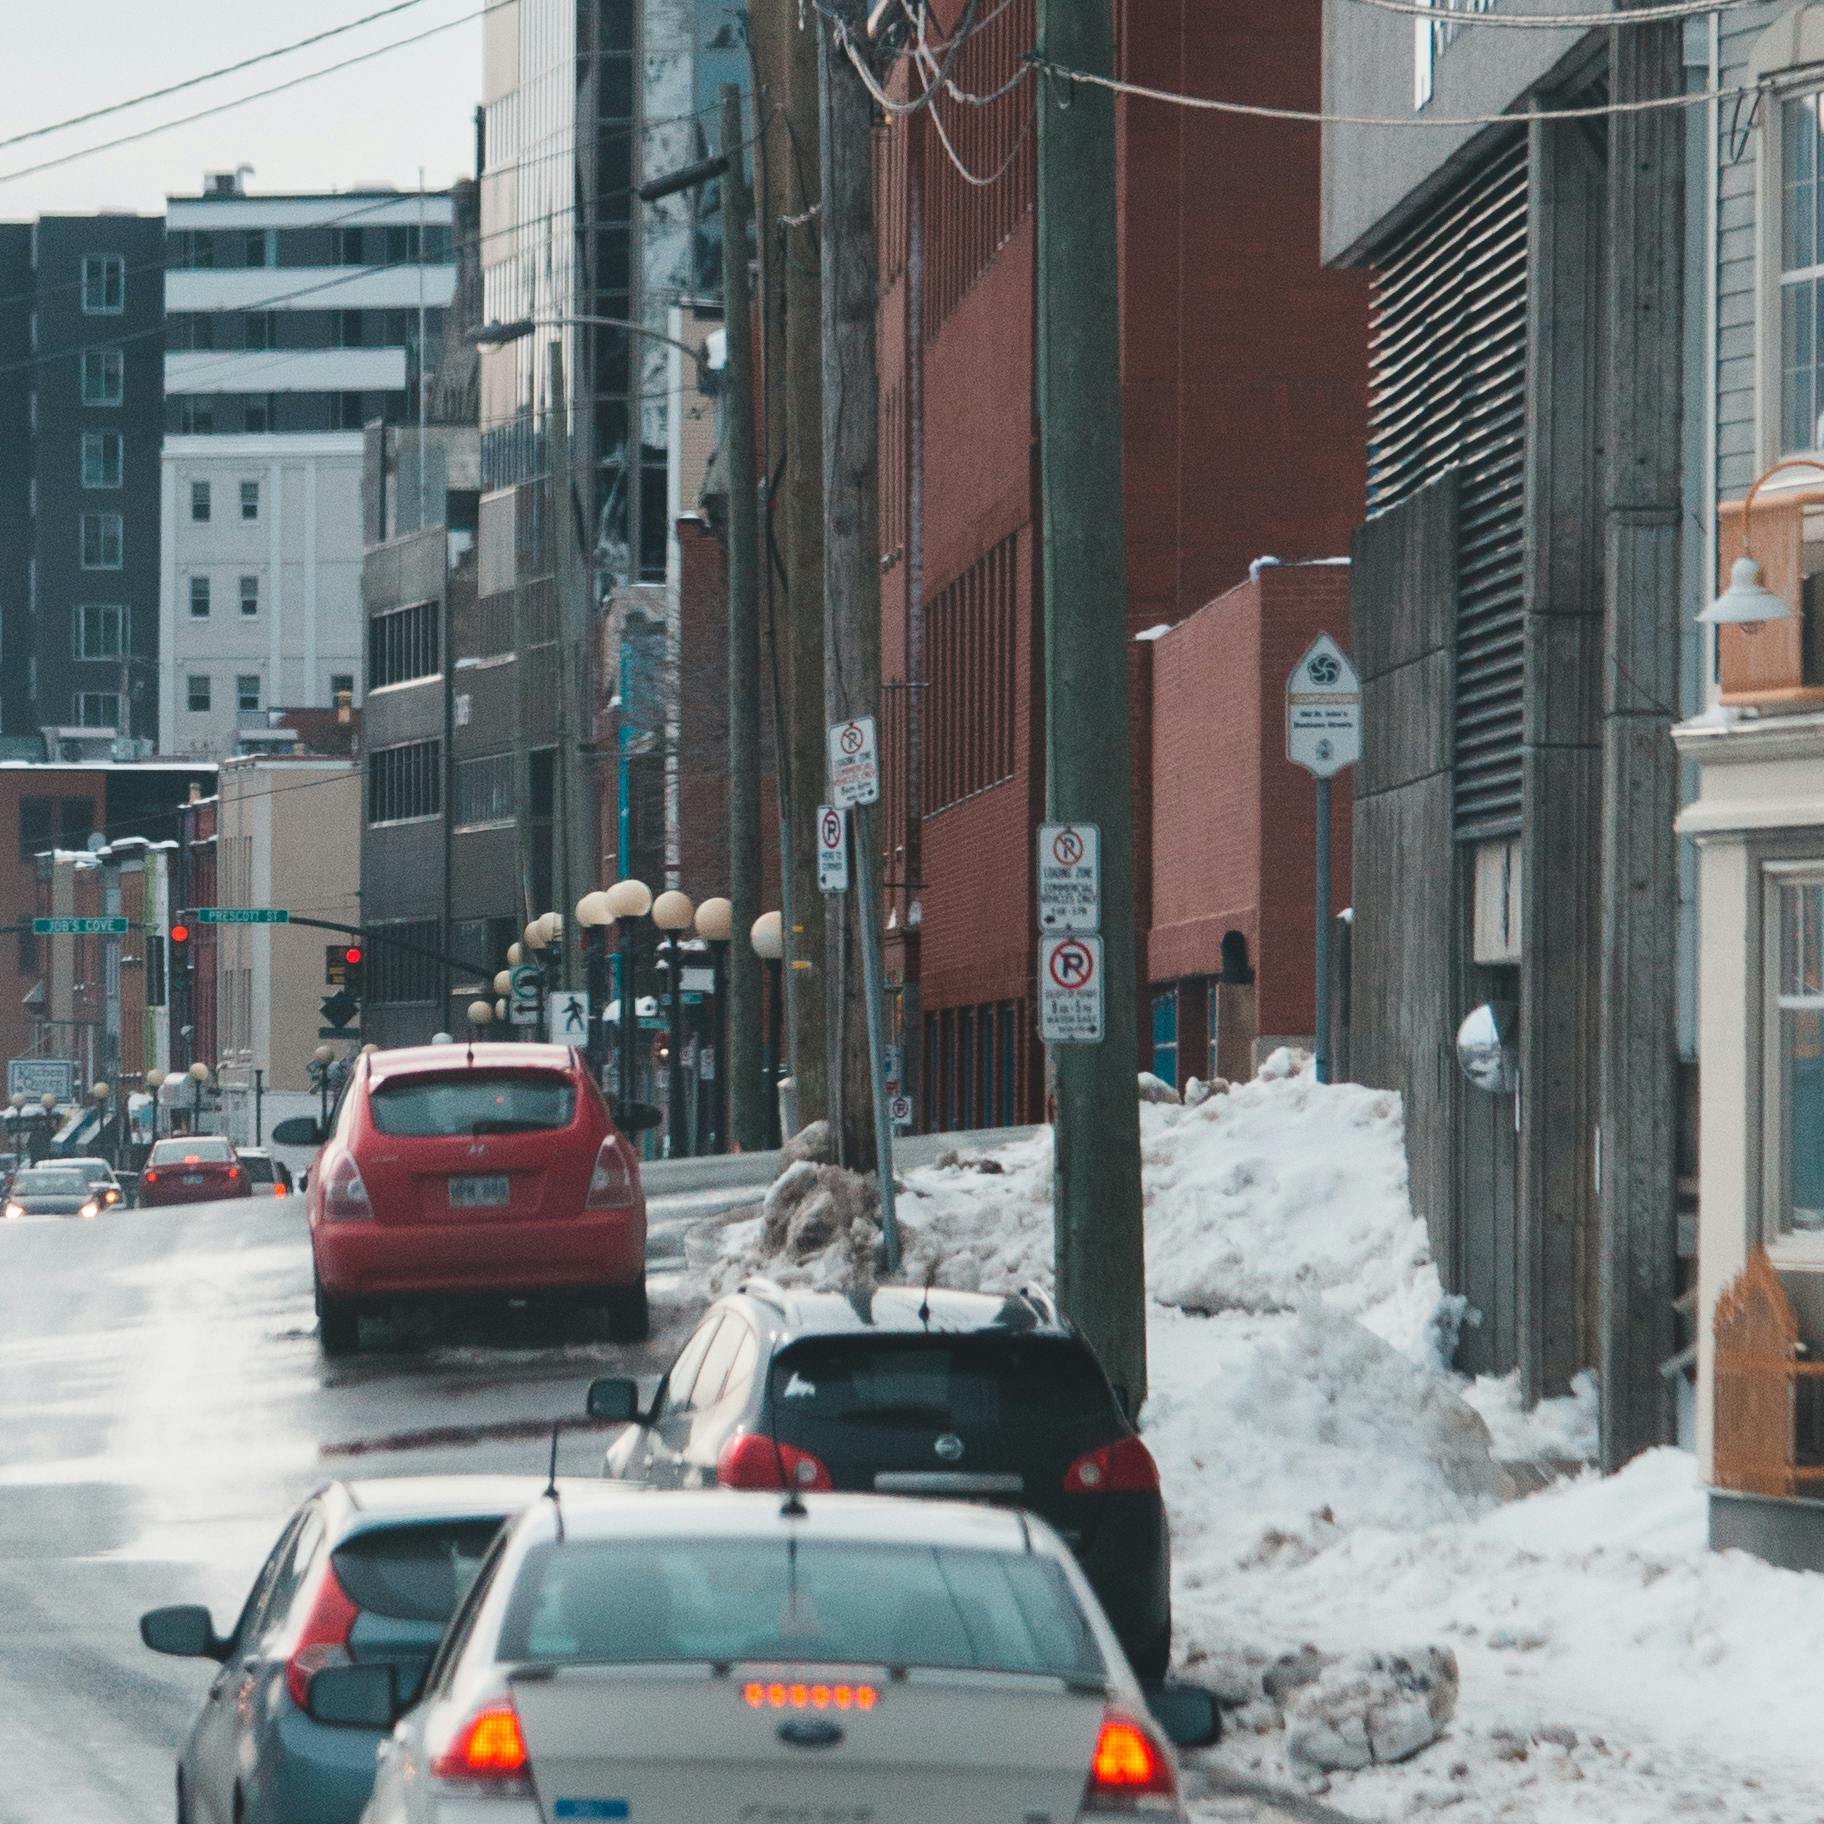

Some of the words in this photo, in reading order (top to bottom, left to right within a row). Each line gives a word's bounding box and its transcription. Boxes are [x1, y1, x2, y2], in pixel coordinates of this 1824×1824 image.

[208, 910, 260, 922] PRESCOTT
[47, 920, 78, 932] JOB'S
[85, 919, 116, 932] COVE
